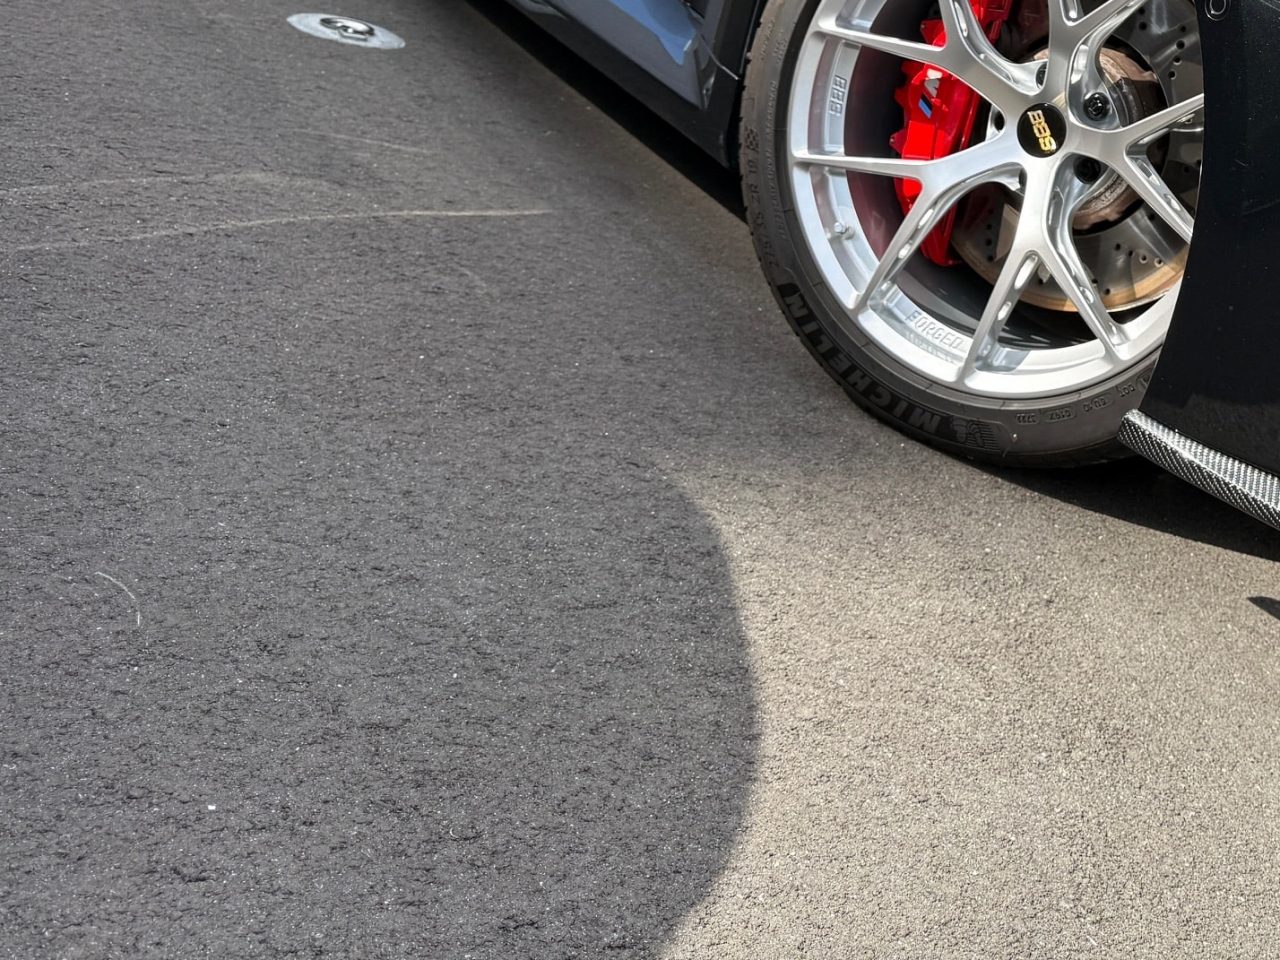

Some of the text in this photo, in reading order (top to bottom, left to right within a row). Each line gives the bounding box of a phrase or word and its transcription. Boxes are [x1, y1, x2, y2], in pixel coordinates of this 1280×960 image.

[1026, 110, 1057, 152] BBS
[904, 309, 965, 350] FORGED
[784, 293, 942, 434] MICHELIN
